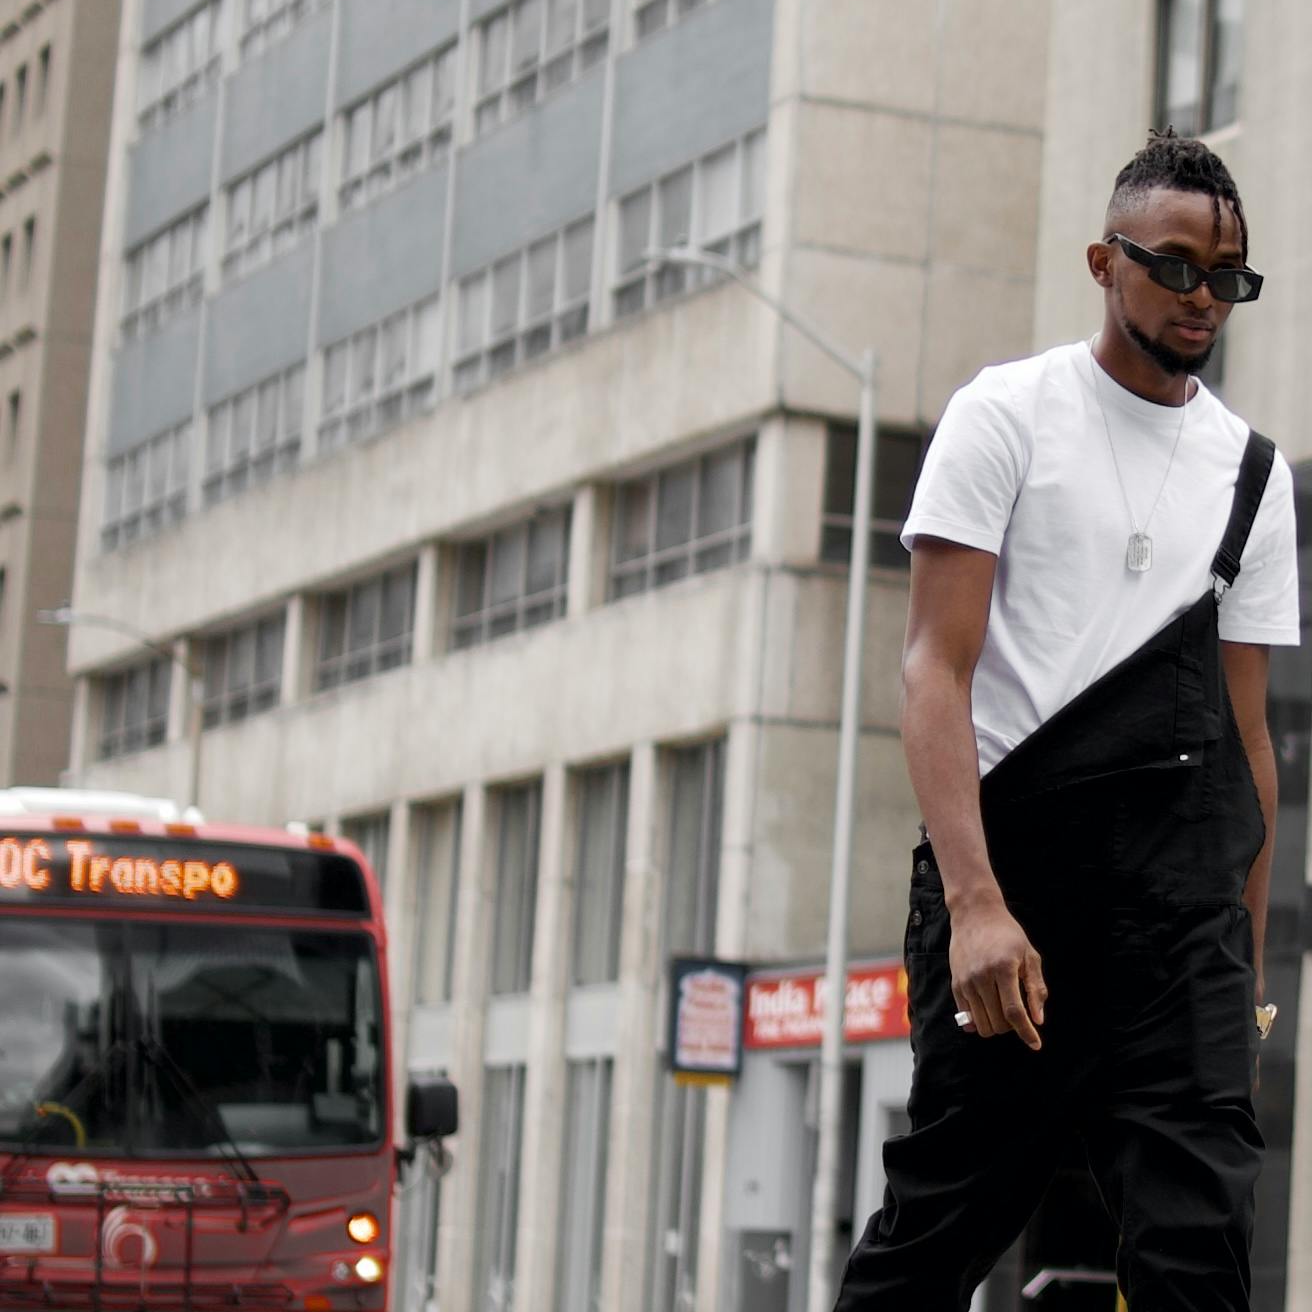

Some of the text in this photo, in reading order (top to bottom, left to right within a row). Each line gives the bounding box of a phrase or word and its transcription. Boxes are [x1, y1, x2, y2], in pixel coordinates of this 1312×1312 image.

[0, 836, 244, 901] OC Transpo
[749, 975, 891, 1017] India Pace
